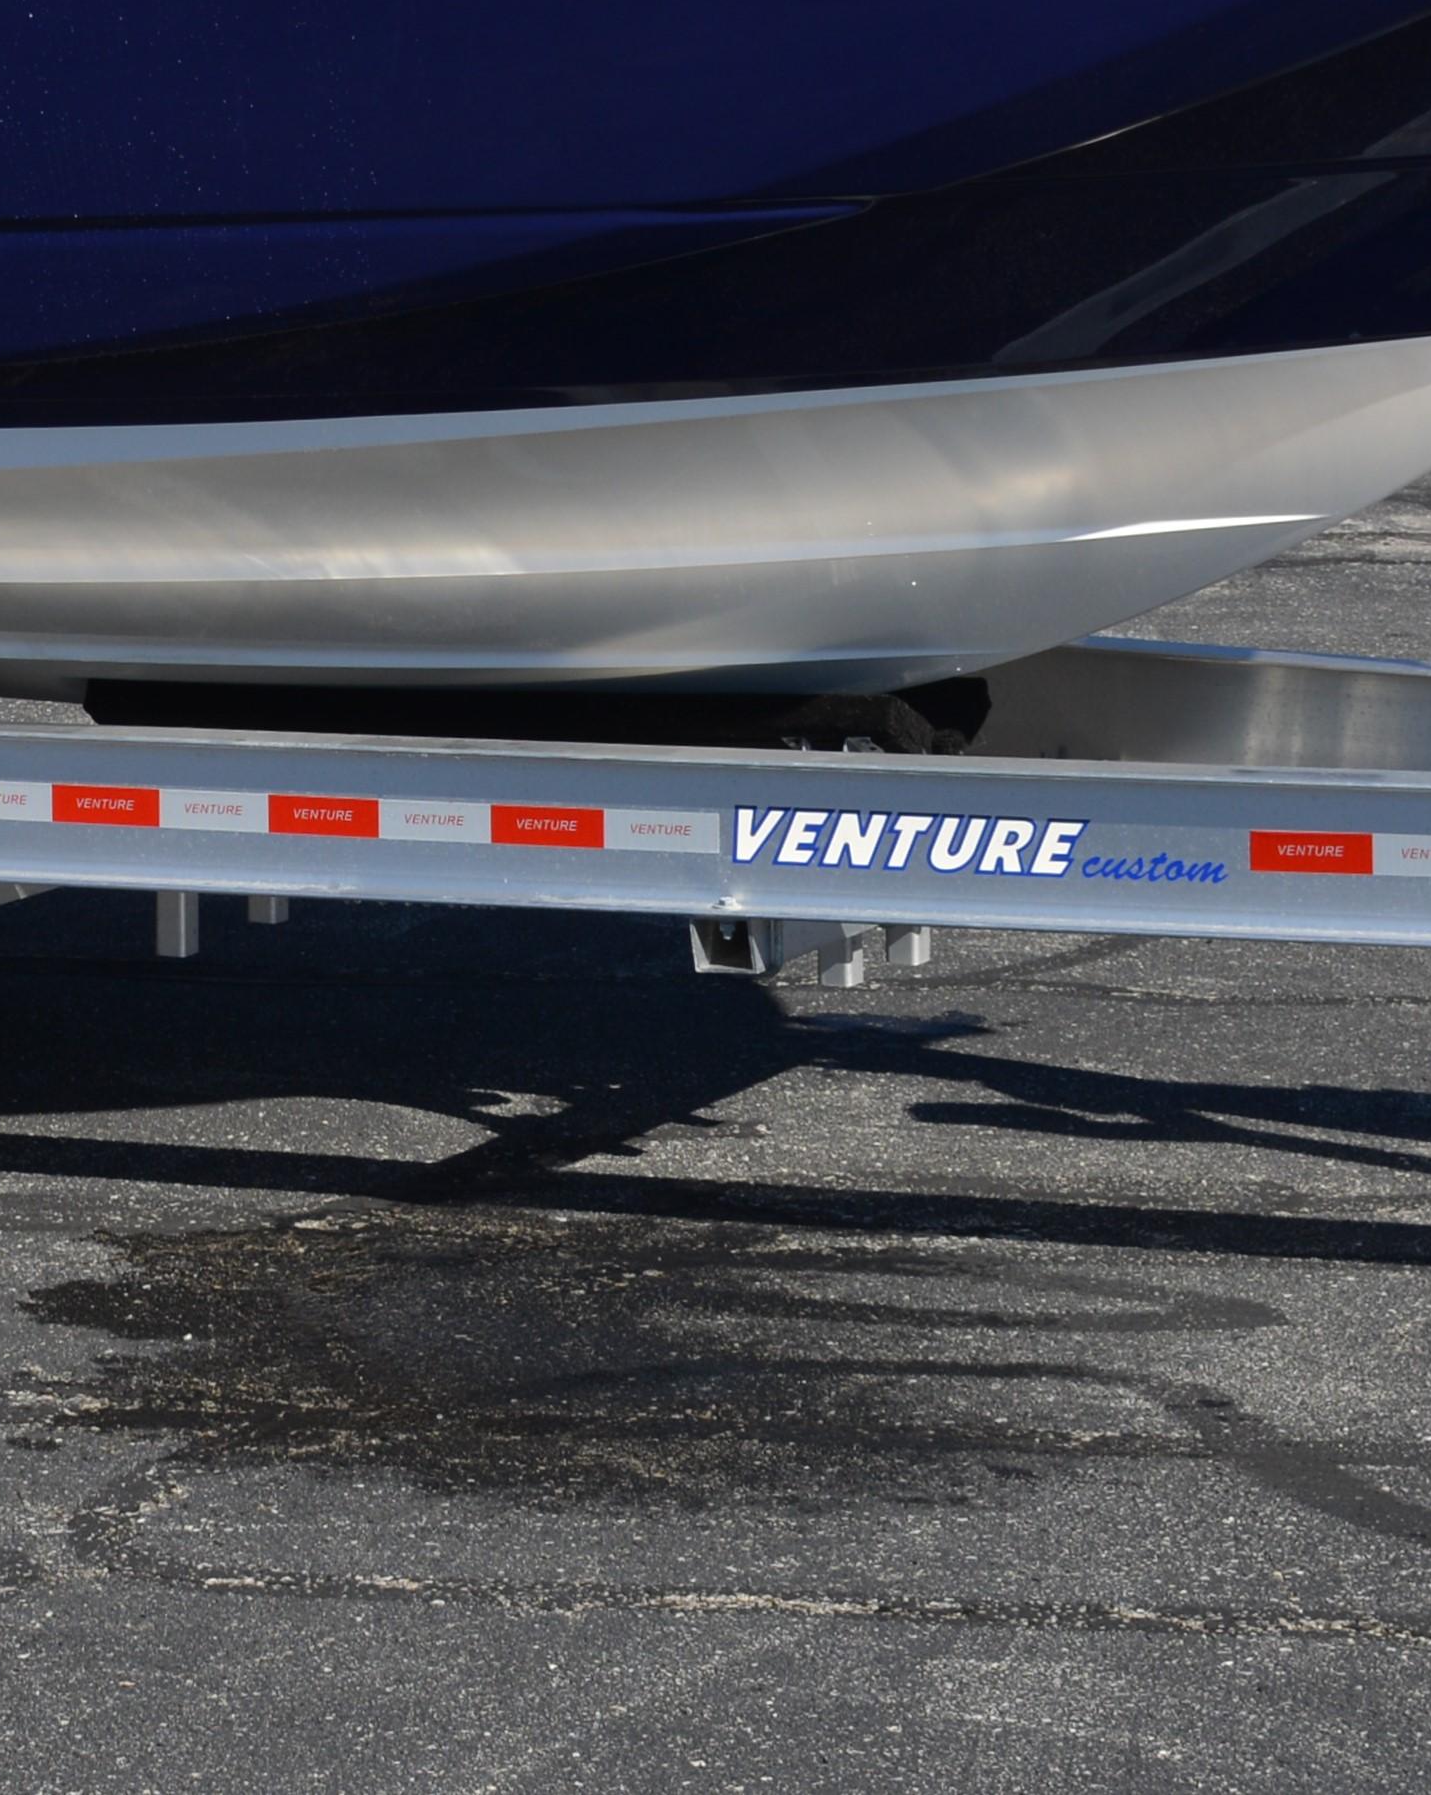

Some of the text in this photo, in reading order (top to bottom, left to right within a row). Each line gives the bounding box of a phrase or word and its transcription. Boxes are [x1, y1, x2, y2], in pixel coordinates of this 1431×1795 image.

[76, 797, 135, 811] VENTURE
[184, 802, 243, 816] VENTURE
[293, 808, 353, 822] VENTURE
[404, 813, 465, 827] VENTURE
[516, 818, 577, 832] VENTURE
[629, 823, 692, 837] VENTURE
[733, 805, 1229, 884] VENTURE custom
[1277, 843, 1344, 858] VENTURE
